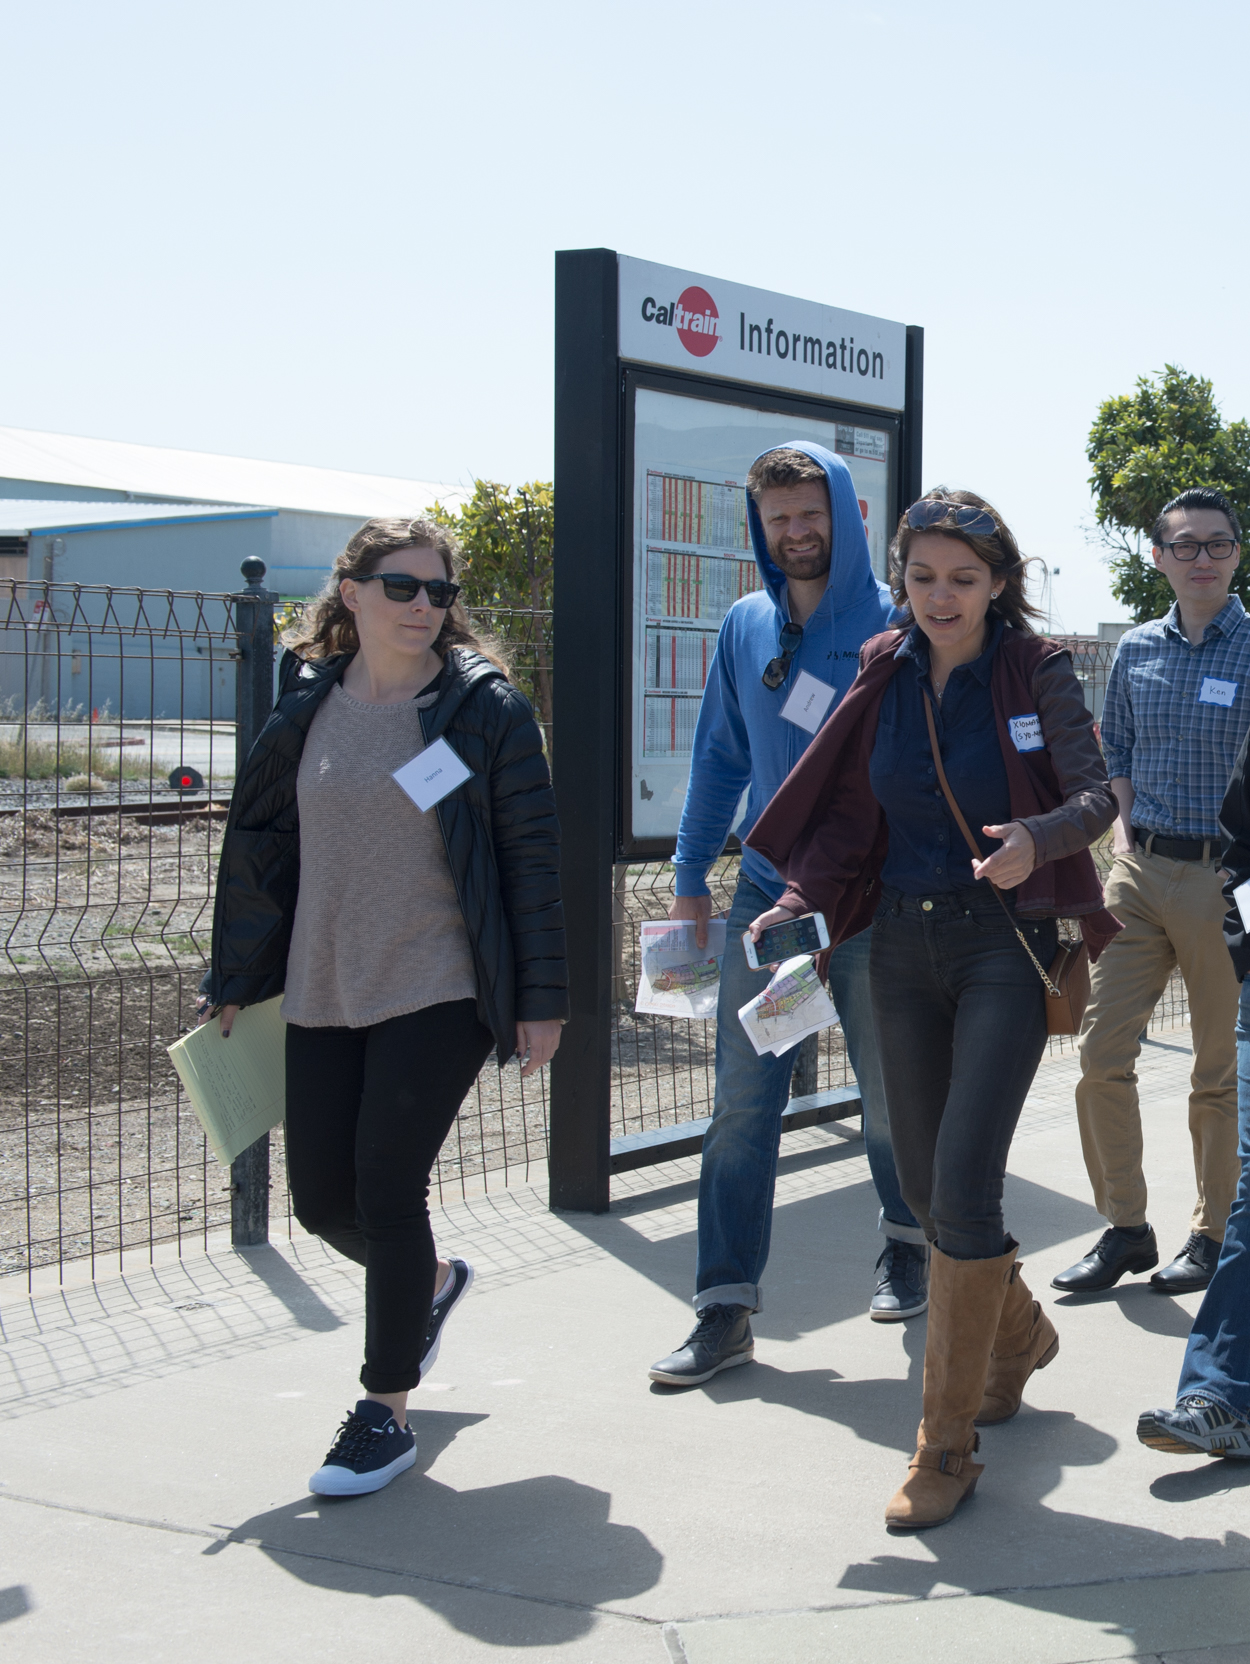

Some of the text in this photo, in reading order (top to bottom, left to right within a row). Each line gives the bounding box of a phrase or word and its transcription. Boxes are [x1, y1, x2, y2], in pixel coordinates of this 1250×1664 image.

[641, 296, 884, 380] Caltrain Information
[1209, 685, 1226, 696] Ken
[803, 693, 816, 712] Andrew
[423, 767, 443, 783] Hanna
